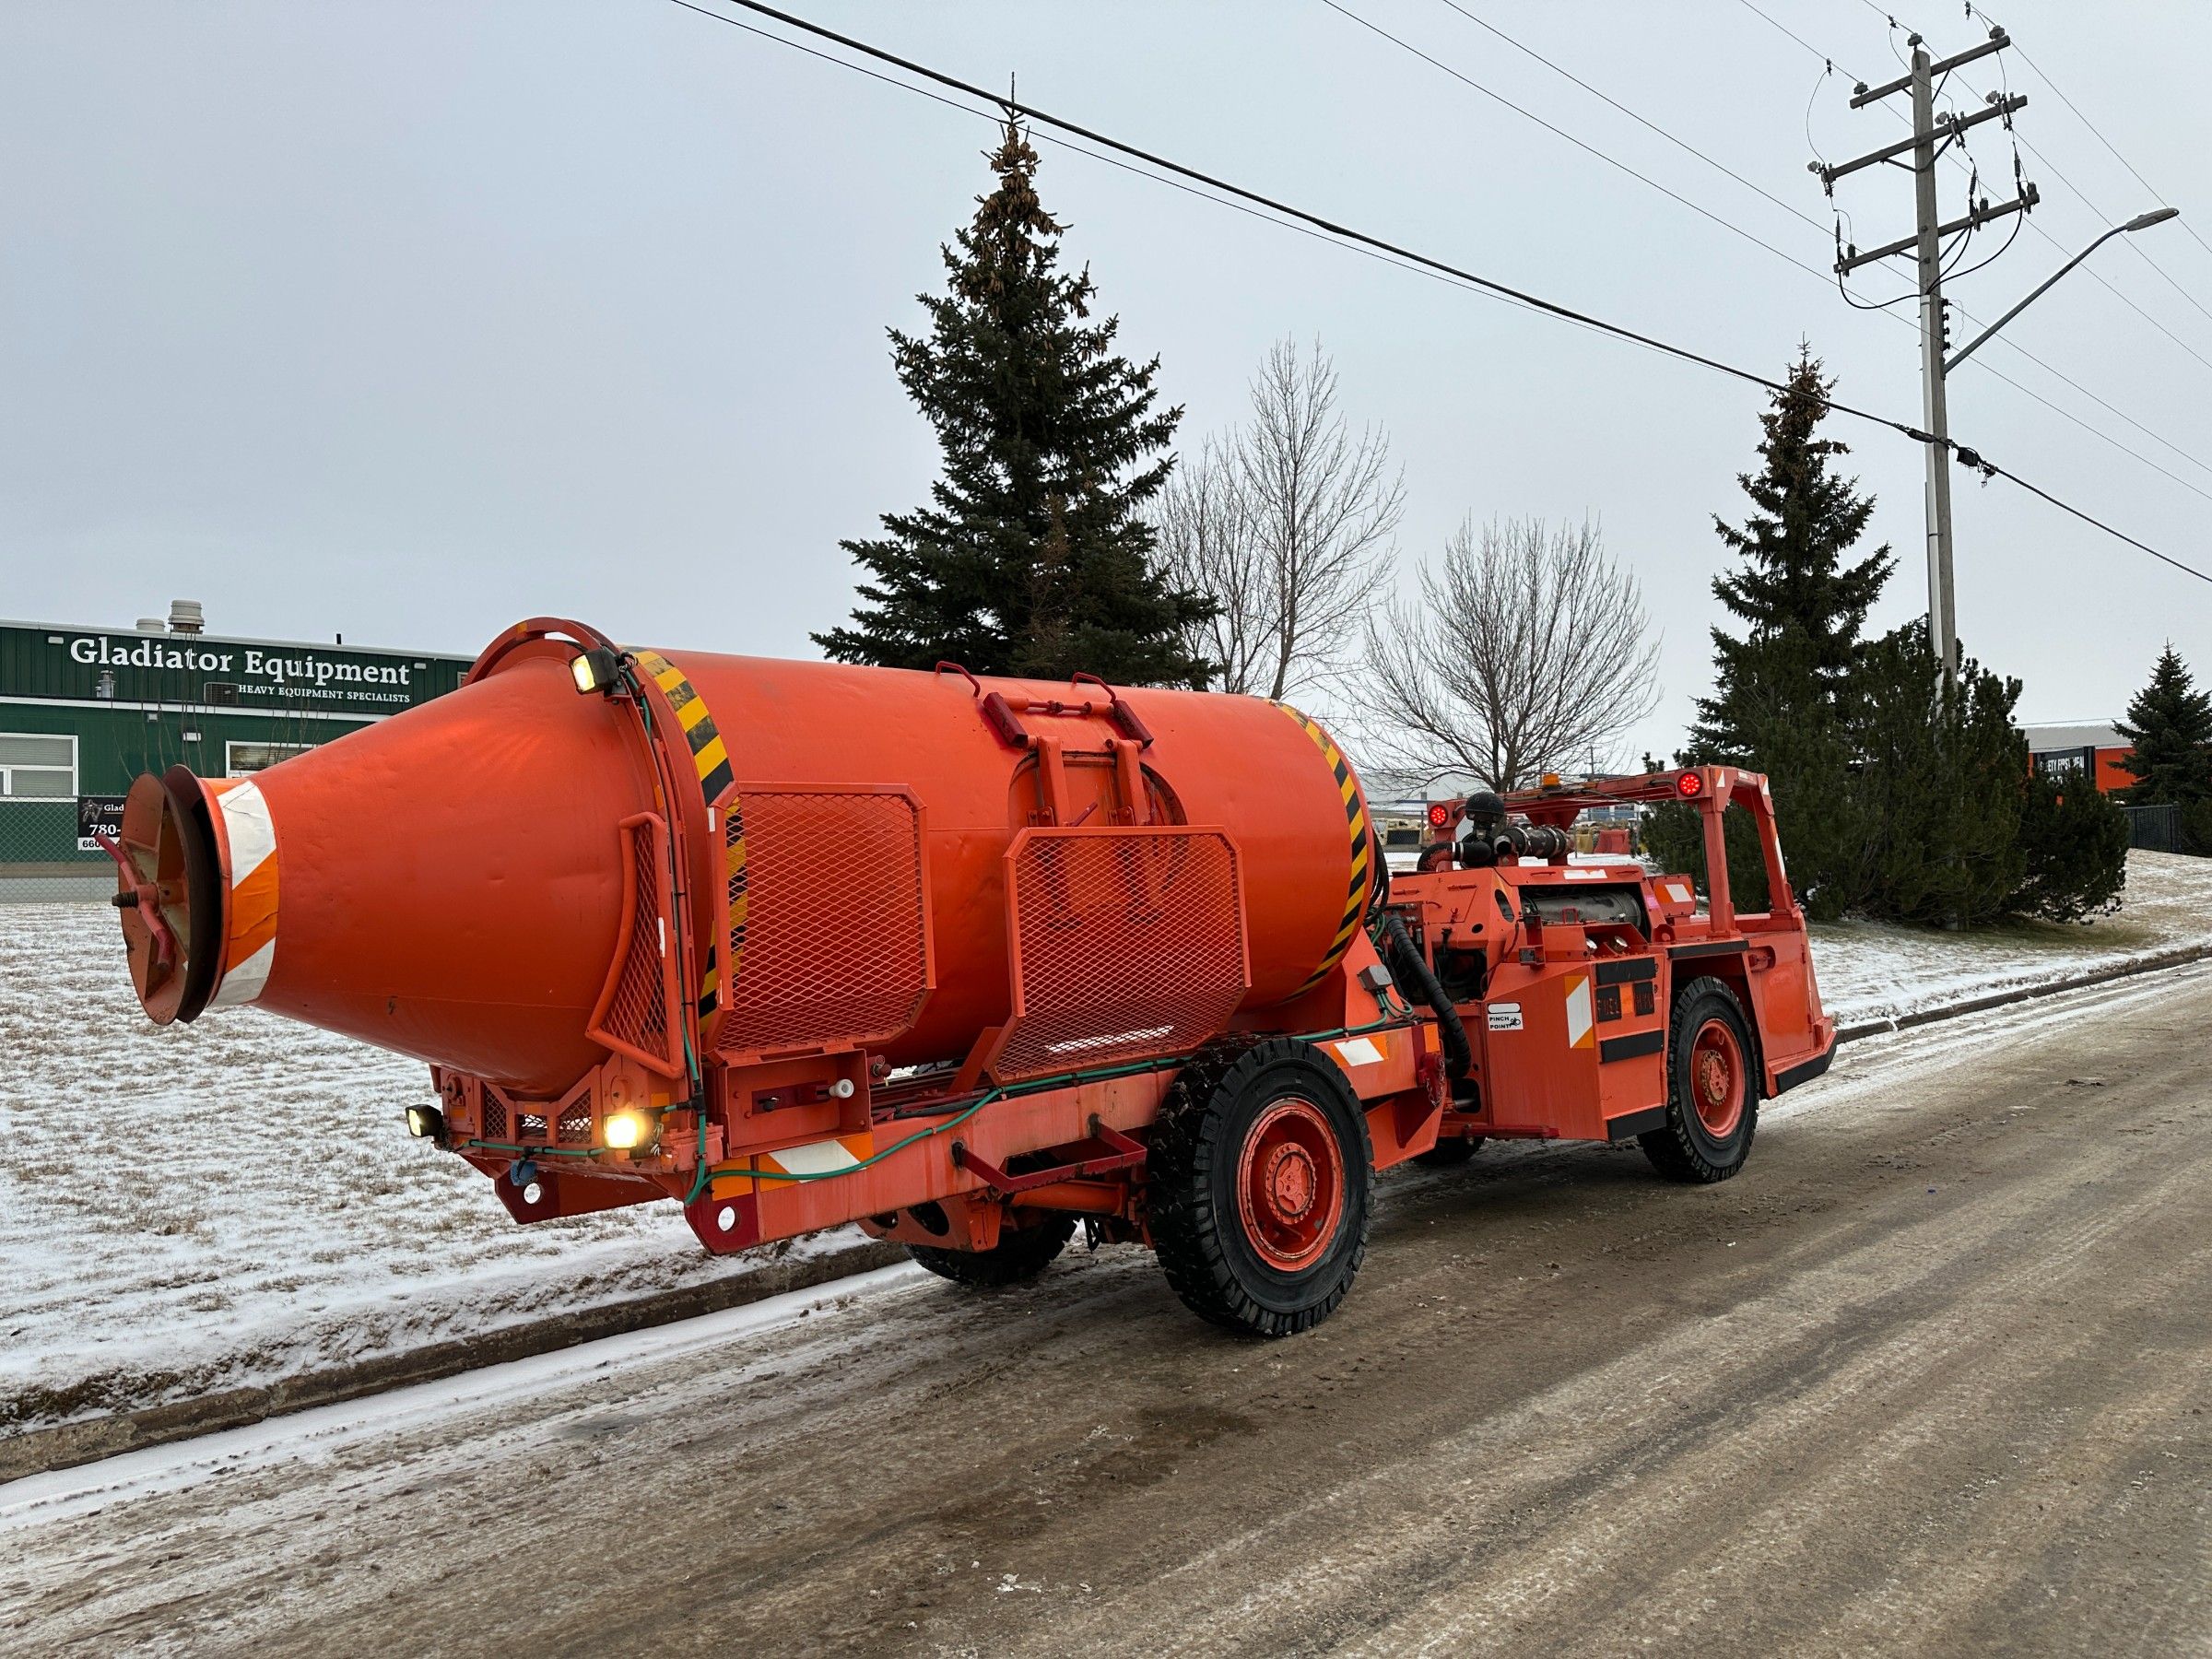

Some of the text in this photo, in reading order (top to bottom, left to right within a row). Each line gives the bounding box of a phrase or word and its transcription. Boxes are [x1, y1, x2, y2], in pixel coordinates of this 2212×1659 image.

[70, 636, 410, 686] Gladiator Equipment
[238, 684, 410, 703] HEAVY EQUIPMENT SPECIALISTS
